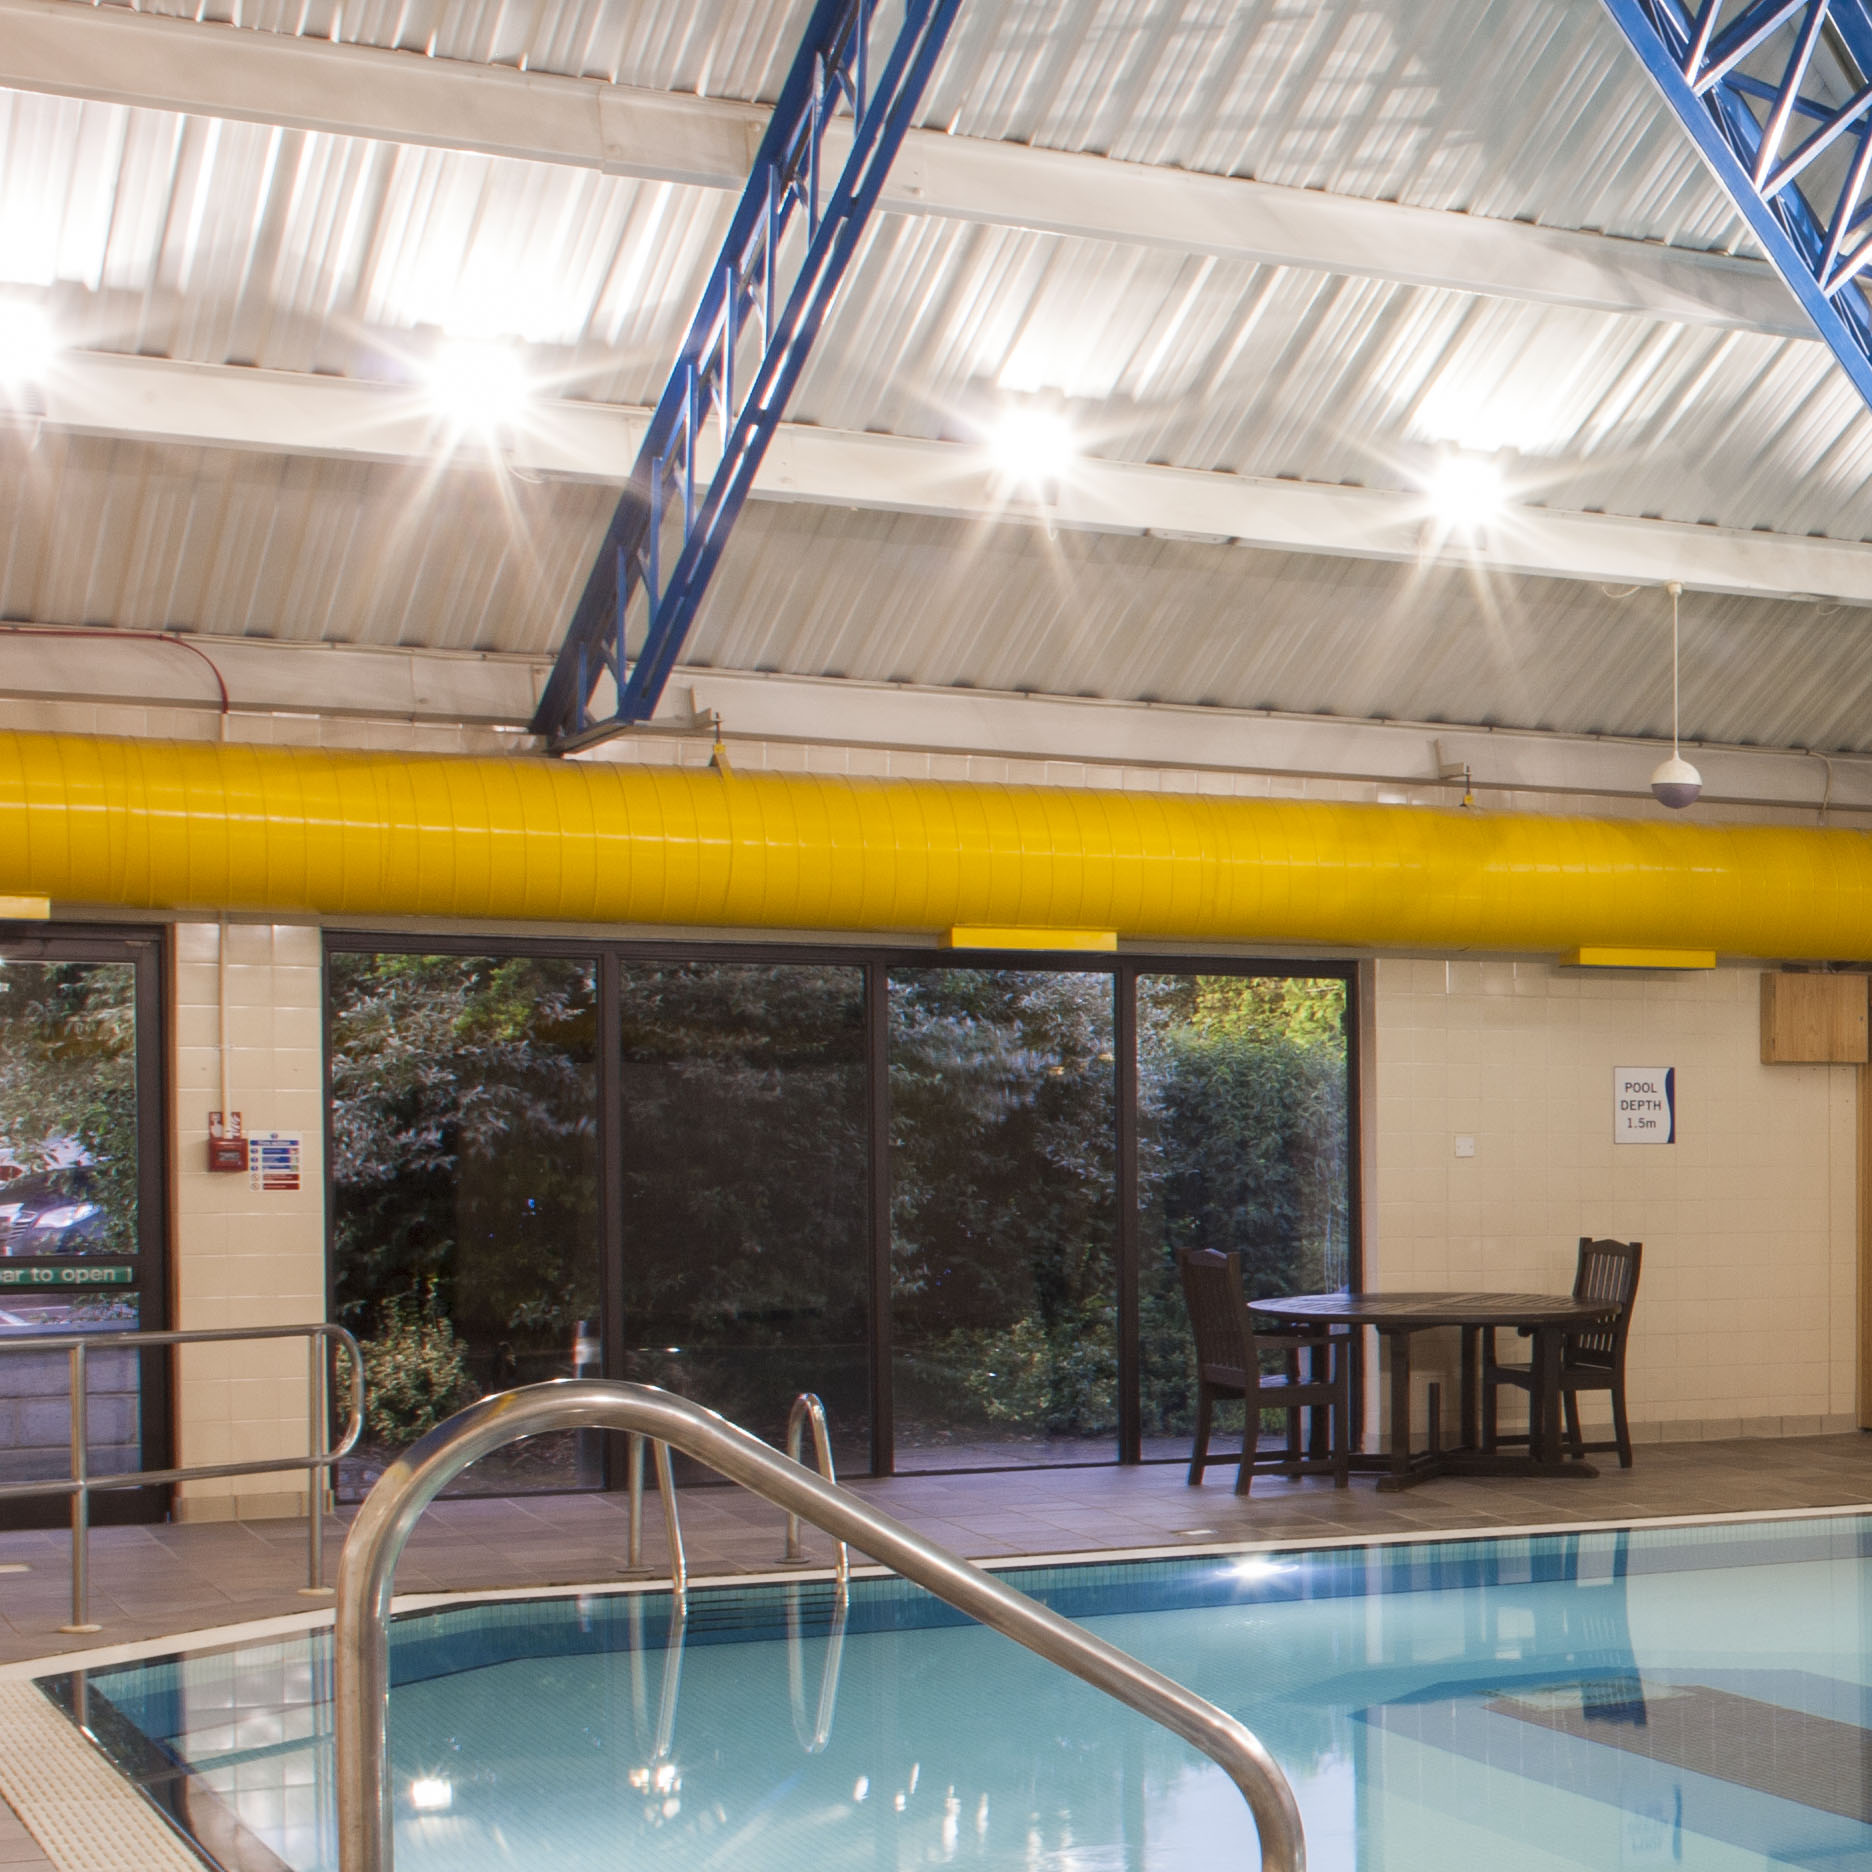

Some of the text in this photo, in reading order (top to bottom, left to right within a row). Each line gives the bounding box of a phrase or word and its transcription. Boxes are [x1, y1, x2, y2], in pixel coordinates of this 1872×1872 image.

[1624, 1082, 1658, 1093] POOL
[1620, 1100, 1662, 1111] DEPTH
[1627, 1117, 1657, 1129] 1.5m
[0, 1267, 115, 1285] ar to open
